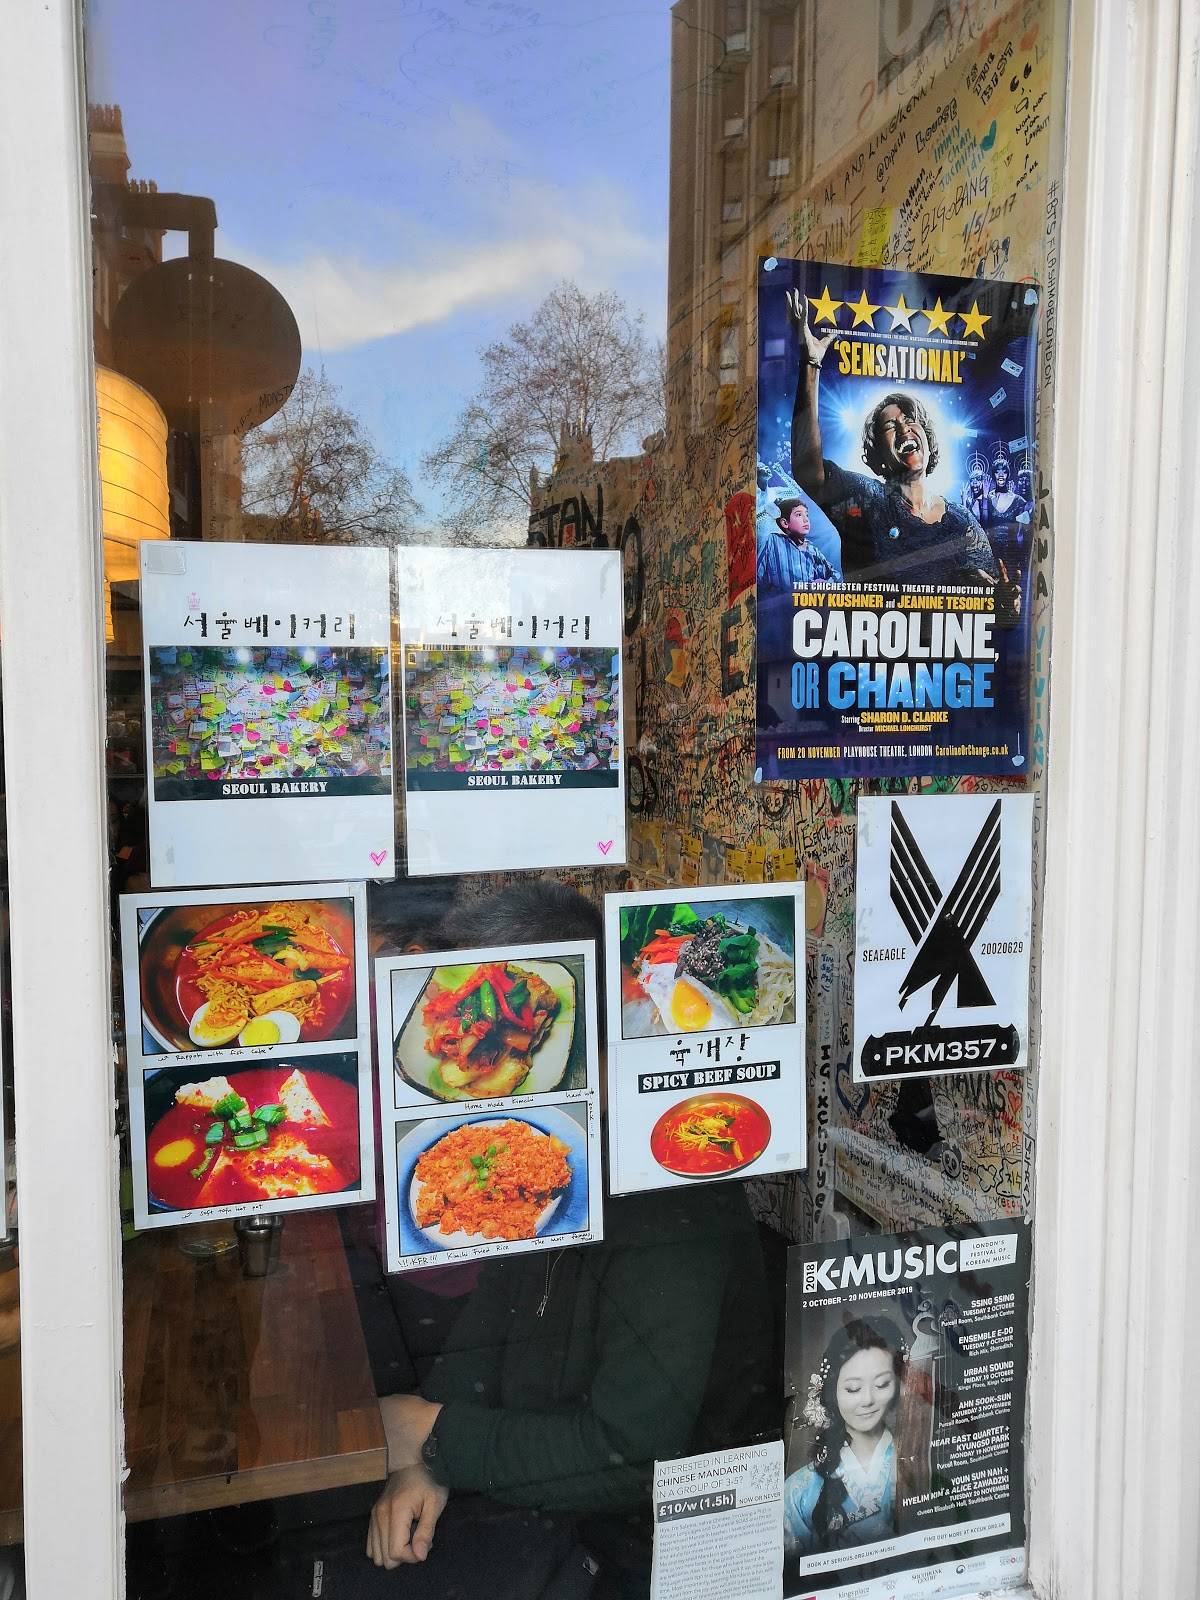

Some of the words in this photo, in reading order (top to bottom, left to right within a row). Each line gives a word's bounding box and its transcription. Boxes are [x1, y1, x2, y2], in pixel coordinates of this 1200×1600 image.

[1046, 181, 1060, 235] #BTS
[833, 340, 966, 384] 'SENSATIONAL'
[793, 582, 808, 590] THE
[811, 582, 861, 591] CHICHESTER
[863, 583, 900, 592] FESTIVAL
[902, 584, 934, 593] THEATRE
[937, 585, 983, 594] PRODUCTION
[985, 586, 995, 594] OF
[792, 593, 826, 607] TONY
[827, 593, 884, 608] KUSHNER
[885, 598, 896, 609] and
[897, 595, 944, 610] JEANINE
[945, 596, 995, 611] TESORI'S
[184, 611, 355, 640] 서울베이커리
[792, 609, 999, 662] CAROLINE,
[791, 661, 820, 710] OR
[827, 661, 995, 710] CHANGE
[841, 715, 860, 725] Starring
[860, 711, 900, 723] SHARON
[901, 711, 911, 724] D.
[912, 711, 949, 723] CLARKE
[874, 724, 899, 733] MICHAEL
[900, 724, 932, 732] LONGHURST
[777, 747, 796, 759] FROM
[797, 747, 806, 758] 20
[807, 746, 841, 758] NOVEMBER
[843, 745, 878, 758] PLAYHOUSE
[879, 745, 907, 758] THEATRE,
[909, 744, 933, 757] LONDON
[935, 744, 1009, 758] CarolineOrChange.co.uk
[222, 783, 268, 795] SEOUL
[271, 782, 328, 794] BAKERY
[467, 775, 508, 787] SEOUL
[511, 774, 562, 786] BAKERY
[862, 948, 906, 962] SEAEAGLE
[981, 942, 1024, 956] 20020629
[669, 1033, 750, 1067] 육개장
[885, 1038, 997, 1067] PKM357
[642, 1073, 689, 1090] SPICY
[694, 1069, 734, 1085] BEEF
[736, 1064, 777, 1080] SOUP
[971, 1248, 997, 1258] FESTIVAL
[972, 1239, 1005, 1249] LONDON'S
[816, 1242, 959, 1291] K-MUSIC
[965, 1257, 991, 1267] KOREAN
[992, 1254, 1011, 1263] MUSIC
[805, 1264, 816, 1291] 2018
[803, 1300, 807, 1308] 2
[808, 1296, 841, 1308] OCTOBER
[848, 1293, 857, 1302] 20
[858, 1288, 896, 1301] NOVEMBER
[897, 1286, 913, 1296] 2018
[971, 1298, 993, 1309] SSING
[994, 1293, 1015, 1304] SSING
[963, 1308, 987, 1317] TUESDAY
[991, 1302, 1015, 1311] OCTOBER
[974, 1312, 999, 1322] Southbank
[959, 1331, 996, 1344] ENSEMBLE
[997, 1326, 1014, 1337] E-DO
[962, 1342, 986, 1351] TUESDAY
[990, 1335, 1014, 1345] OCTOBER
[963, 1365, 988, 1377] URBAN
[989, 1360, 1014, 1371] SOUND
[963, 1376, 983, 1384] FRIDAY
[990, 1369, 1014, 1379] OCTOBER
[952, 1407, 978, 1418] SATURDAY
[982, 1401, 1012, 1411] NOVEMBER
[959, 1399, 974, 1410] AHN
[975, 1392, 1012, 1406] SOOK-SUN
[970, 1411, 994, 1421] Southbank
[930, 1436, 950, 1448] NEAR
[951, 1433, 971, 1444] EAST
[972, 1425, 1004, 1439] QUARTET
[956, 1438, 990, 1451] KYUNGSO
[991, 1433, 1010, 1444] PARK
[949, 1451, 974, 1460] MONDAY
[983, 1442, 1010, 1453] NOVEMBER
[657, 1461, 710, 1477] INTERESTED
[723, 1449, 768, 1464] LEARNING
[656, 1474, 696, 1488] CHINESE
[698, 1463, 748, 1479] MANDARIN
[951, 1475, 971, 1486] YOUN
[971, 1471, 986, 1481] SUN
[987, 1467, 1003, 1477] NAH
[656, 1491, 666, 1499] IN
[668, 1489, 675, 1497] A
[676, 1481, 709, 1495] GROUP
[711, 1479, 723, 1489] OF
[726, 1475, 744, 1486] 3-5?
[902, 1494, 929, 1507] HYELIM
[930, 1489, 944, 1500] KIM
[951, 1483, 972, 1494] ALICE
[973, 1475, 1010, 1490] ZAWADZKI
[949, 1492, 972, 1502] TUESDAY
[980, 1484, 1010, 1495] NOVEMBER
[659, 1500, 697, 1517] £10/w
[699, 1493, 734, 1512] (1.5h)
[739, 1497, 753, 1505] NOW
[763, 1491, 781, 1501] NEVER
[968, 1495, 994, 1505] Southbank
[924, 1535, 936, 1543] FIND
[937, 1533, 947, 1541] OUT
[949, 1530, 962, 1539] MORE
[806, 1561, 822, 1569] BOOK
